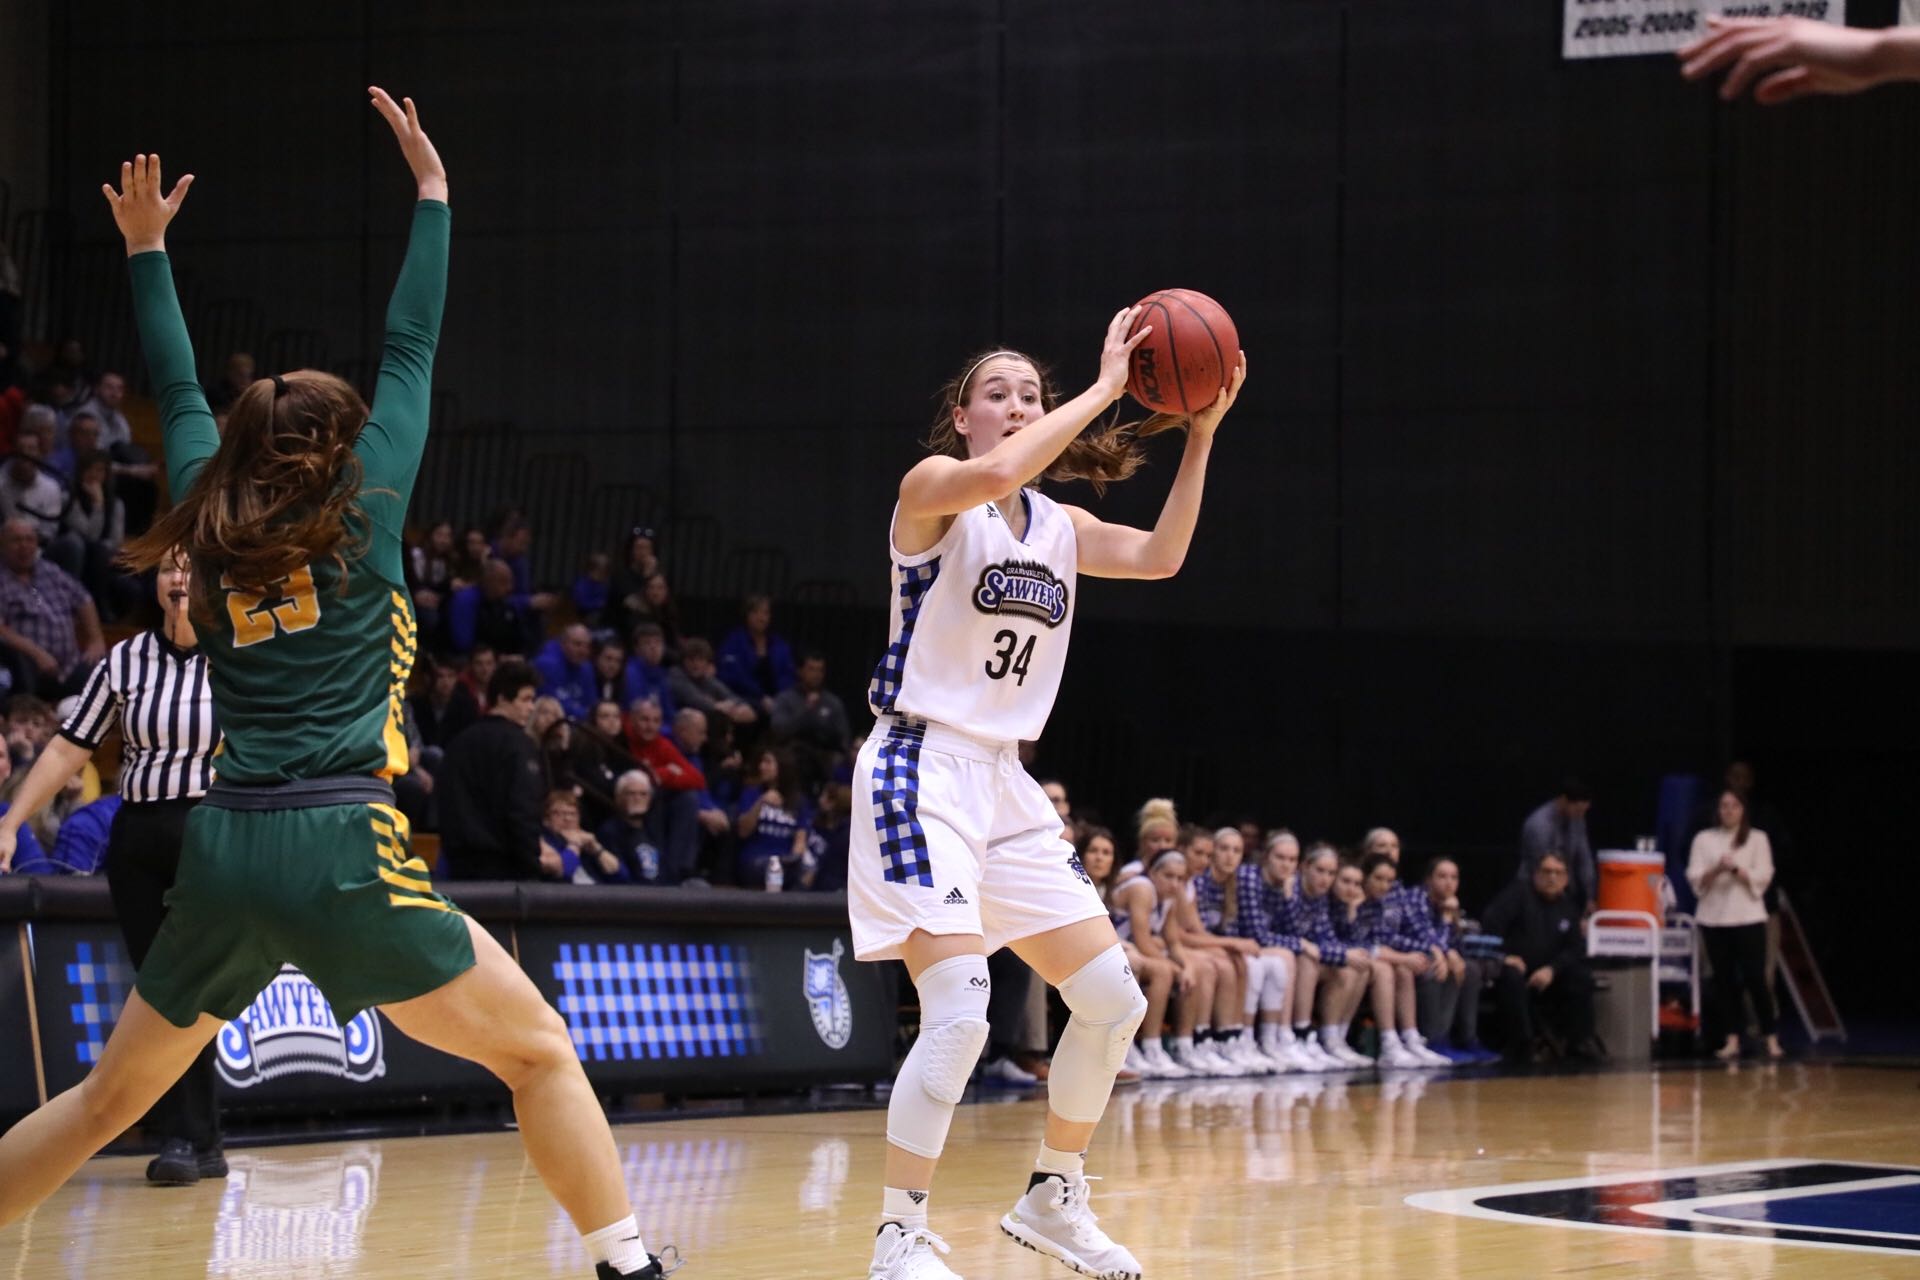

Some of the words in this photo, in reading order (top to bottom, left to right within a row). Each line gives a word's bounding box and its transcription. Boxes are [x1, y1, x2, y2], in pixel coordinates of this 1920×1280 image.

[1134, 347, 1166, 405] NCAA
[980, 571, 1065, 621] SAWYERS
[985, 629, 1037, 687] 34
